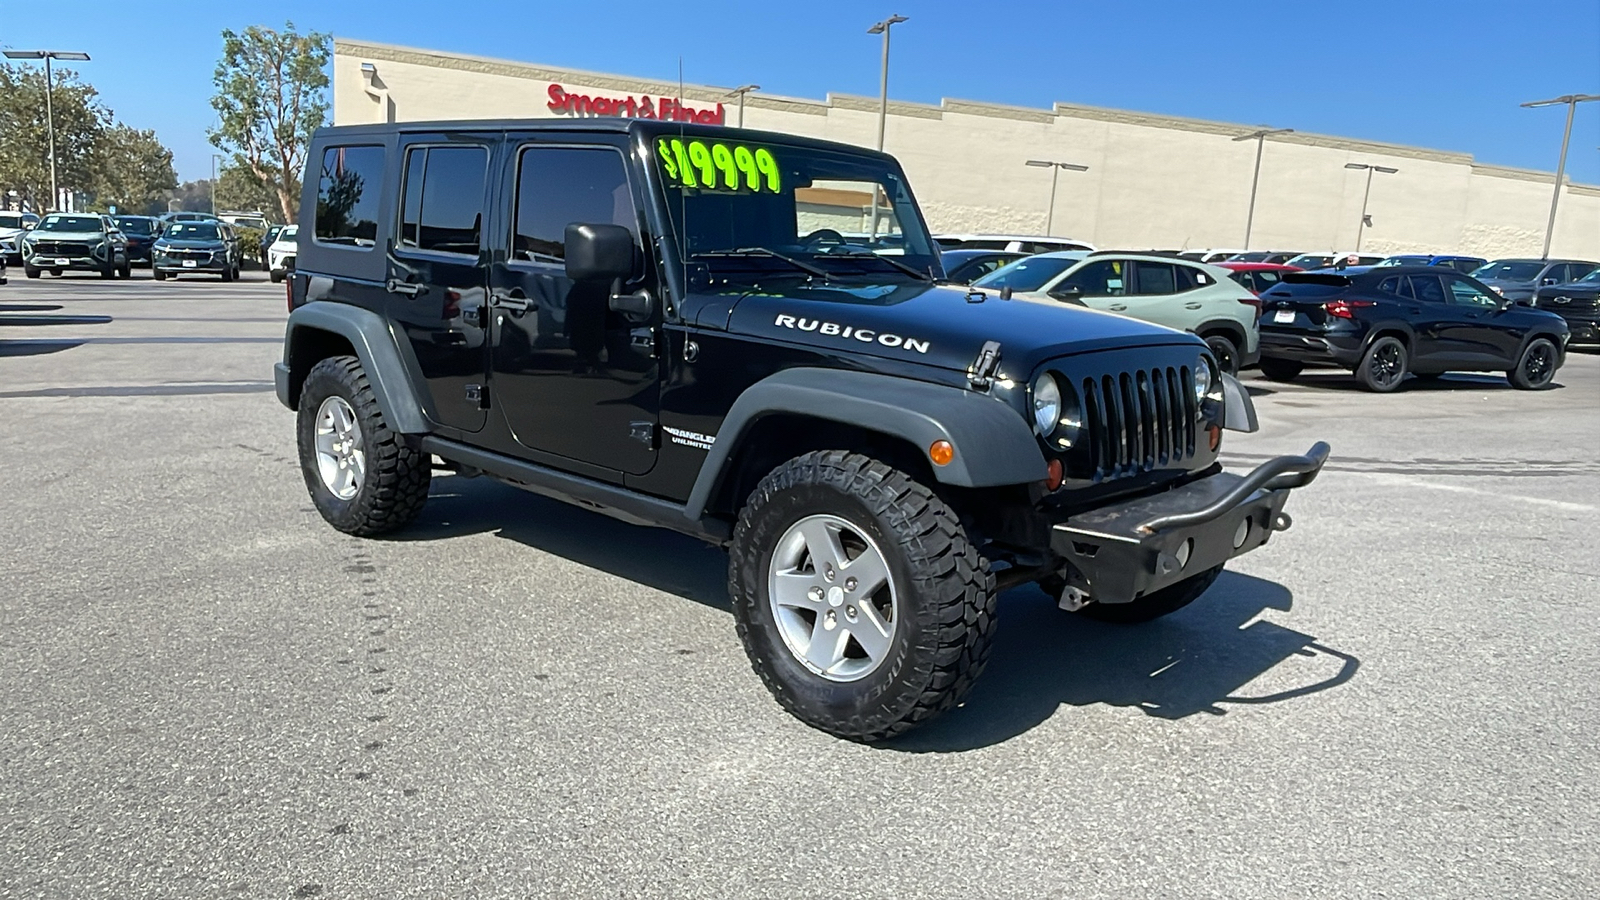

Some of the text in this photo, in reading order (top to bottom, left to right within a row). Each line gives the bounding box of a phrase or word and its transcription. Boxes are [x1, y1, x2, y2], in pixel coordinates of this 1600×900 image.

[547, 84, 724, 125] Smart & Final
[658, 138, 781, 194] $19999
[774, 314, 930, 353] RUBICON
